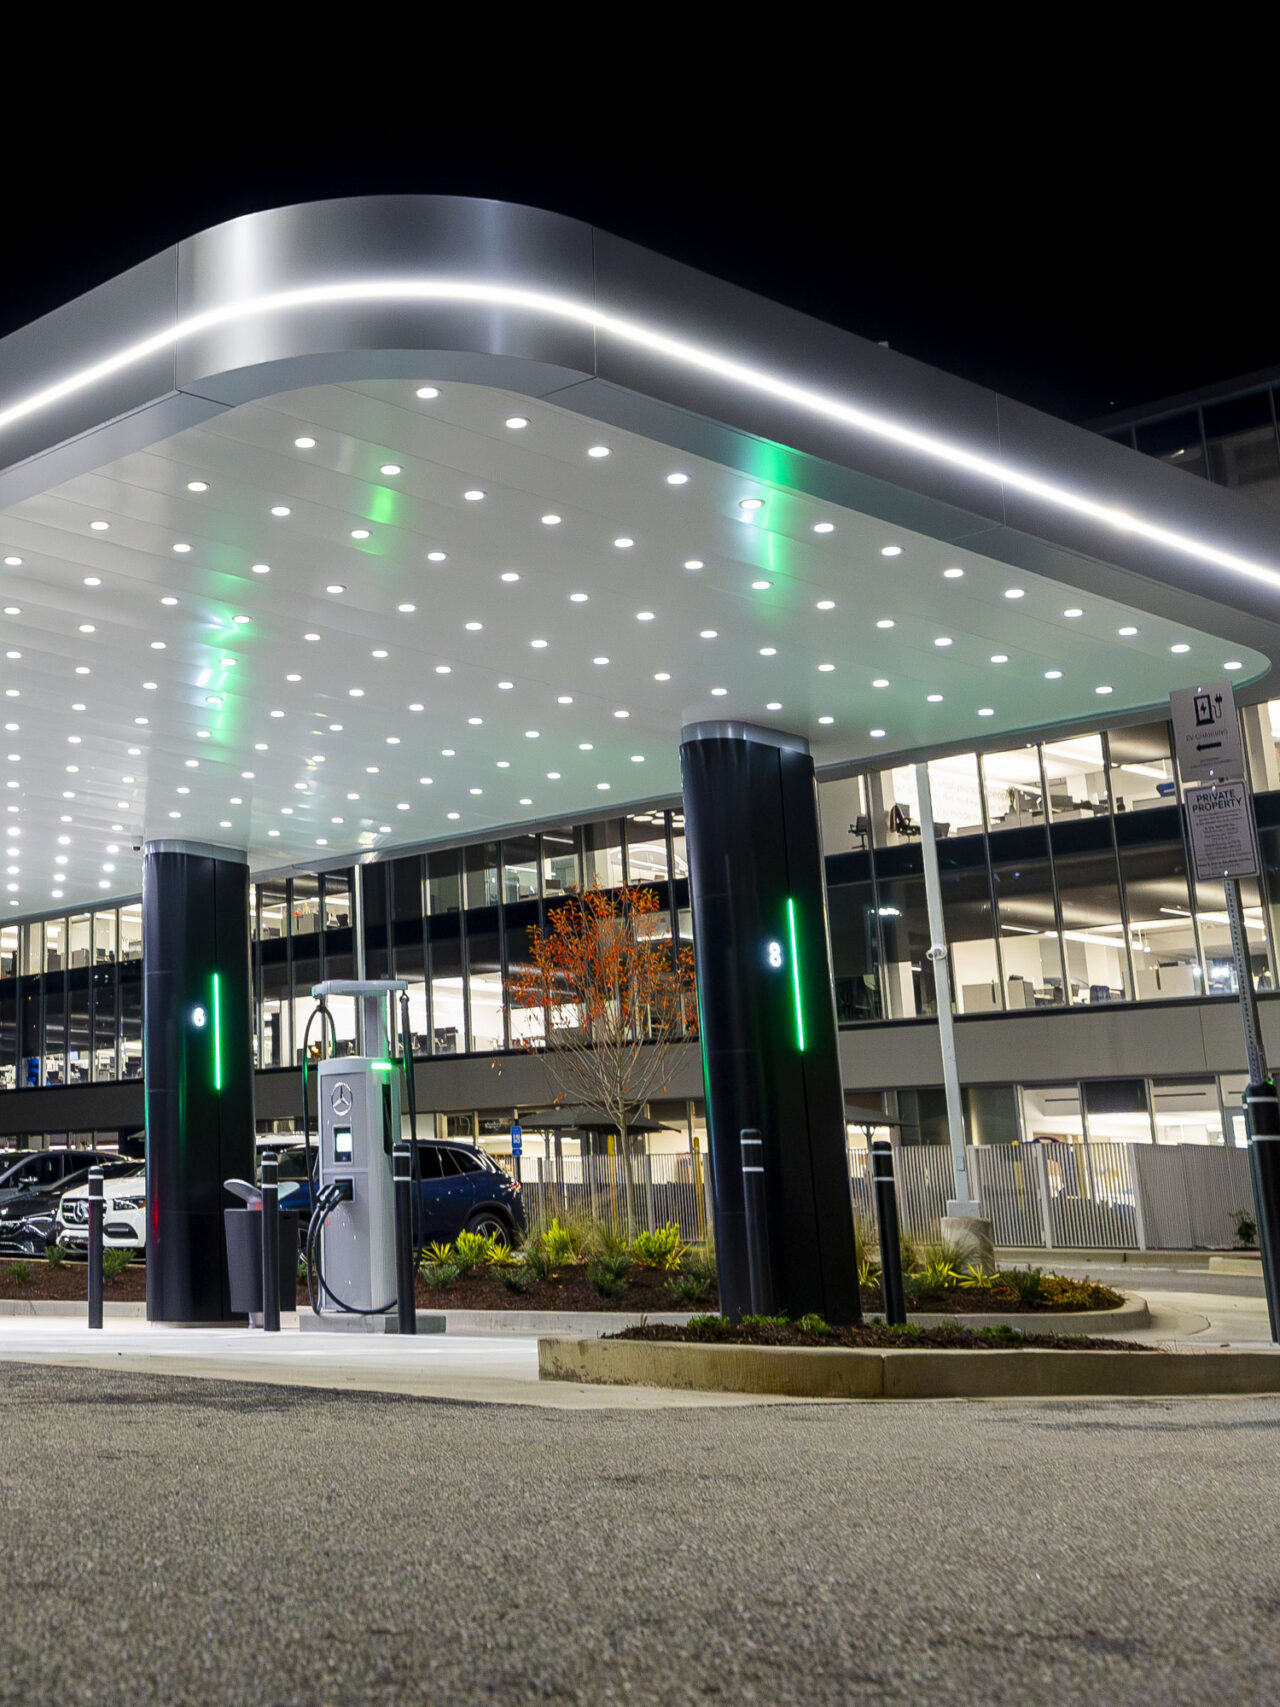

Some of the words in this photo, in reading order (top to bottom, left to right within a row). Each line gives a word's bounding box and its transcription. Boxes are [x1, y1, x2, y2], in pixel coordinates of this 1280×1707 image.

[1192, 797, 1242, 813] PROPERTY
[1196, 788, 1236, 803] PRIVATE
[769, 941, 782, 968] 8
[193, 1006, 205, 1028] 6
